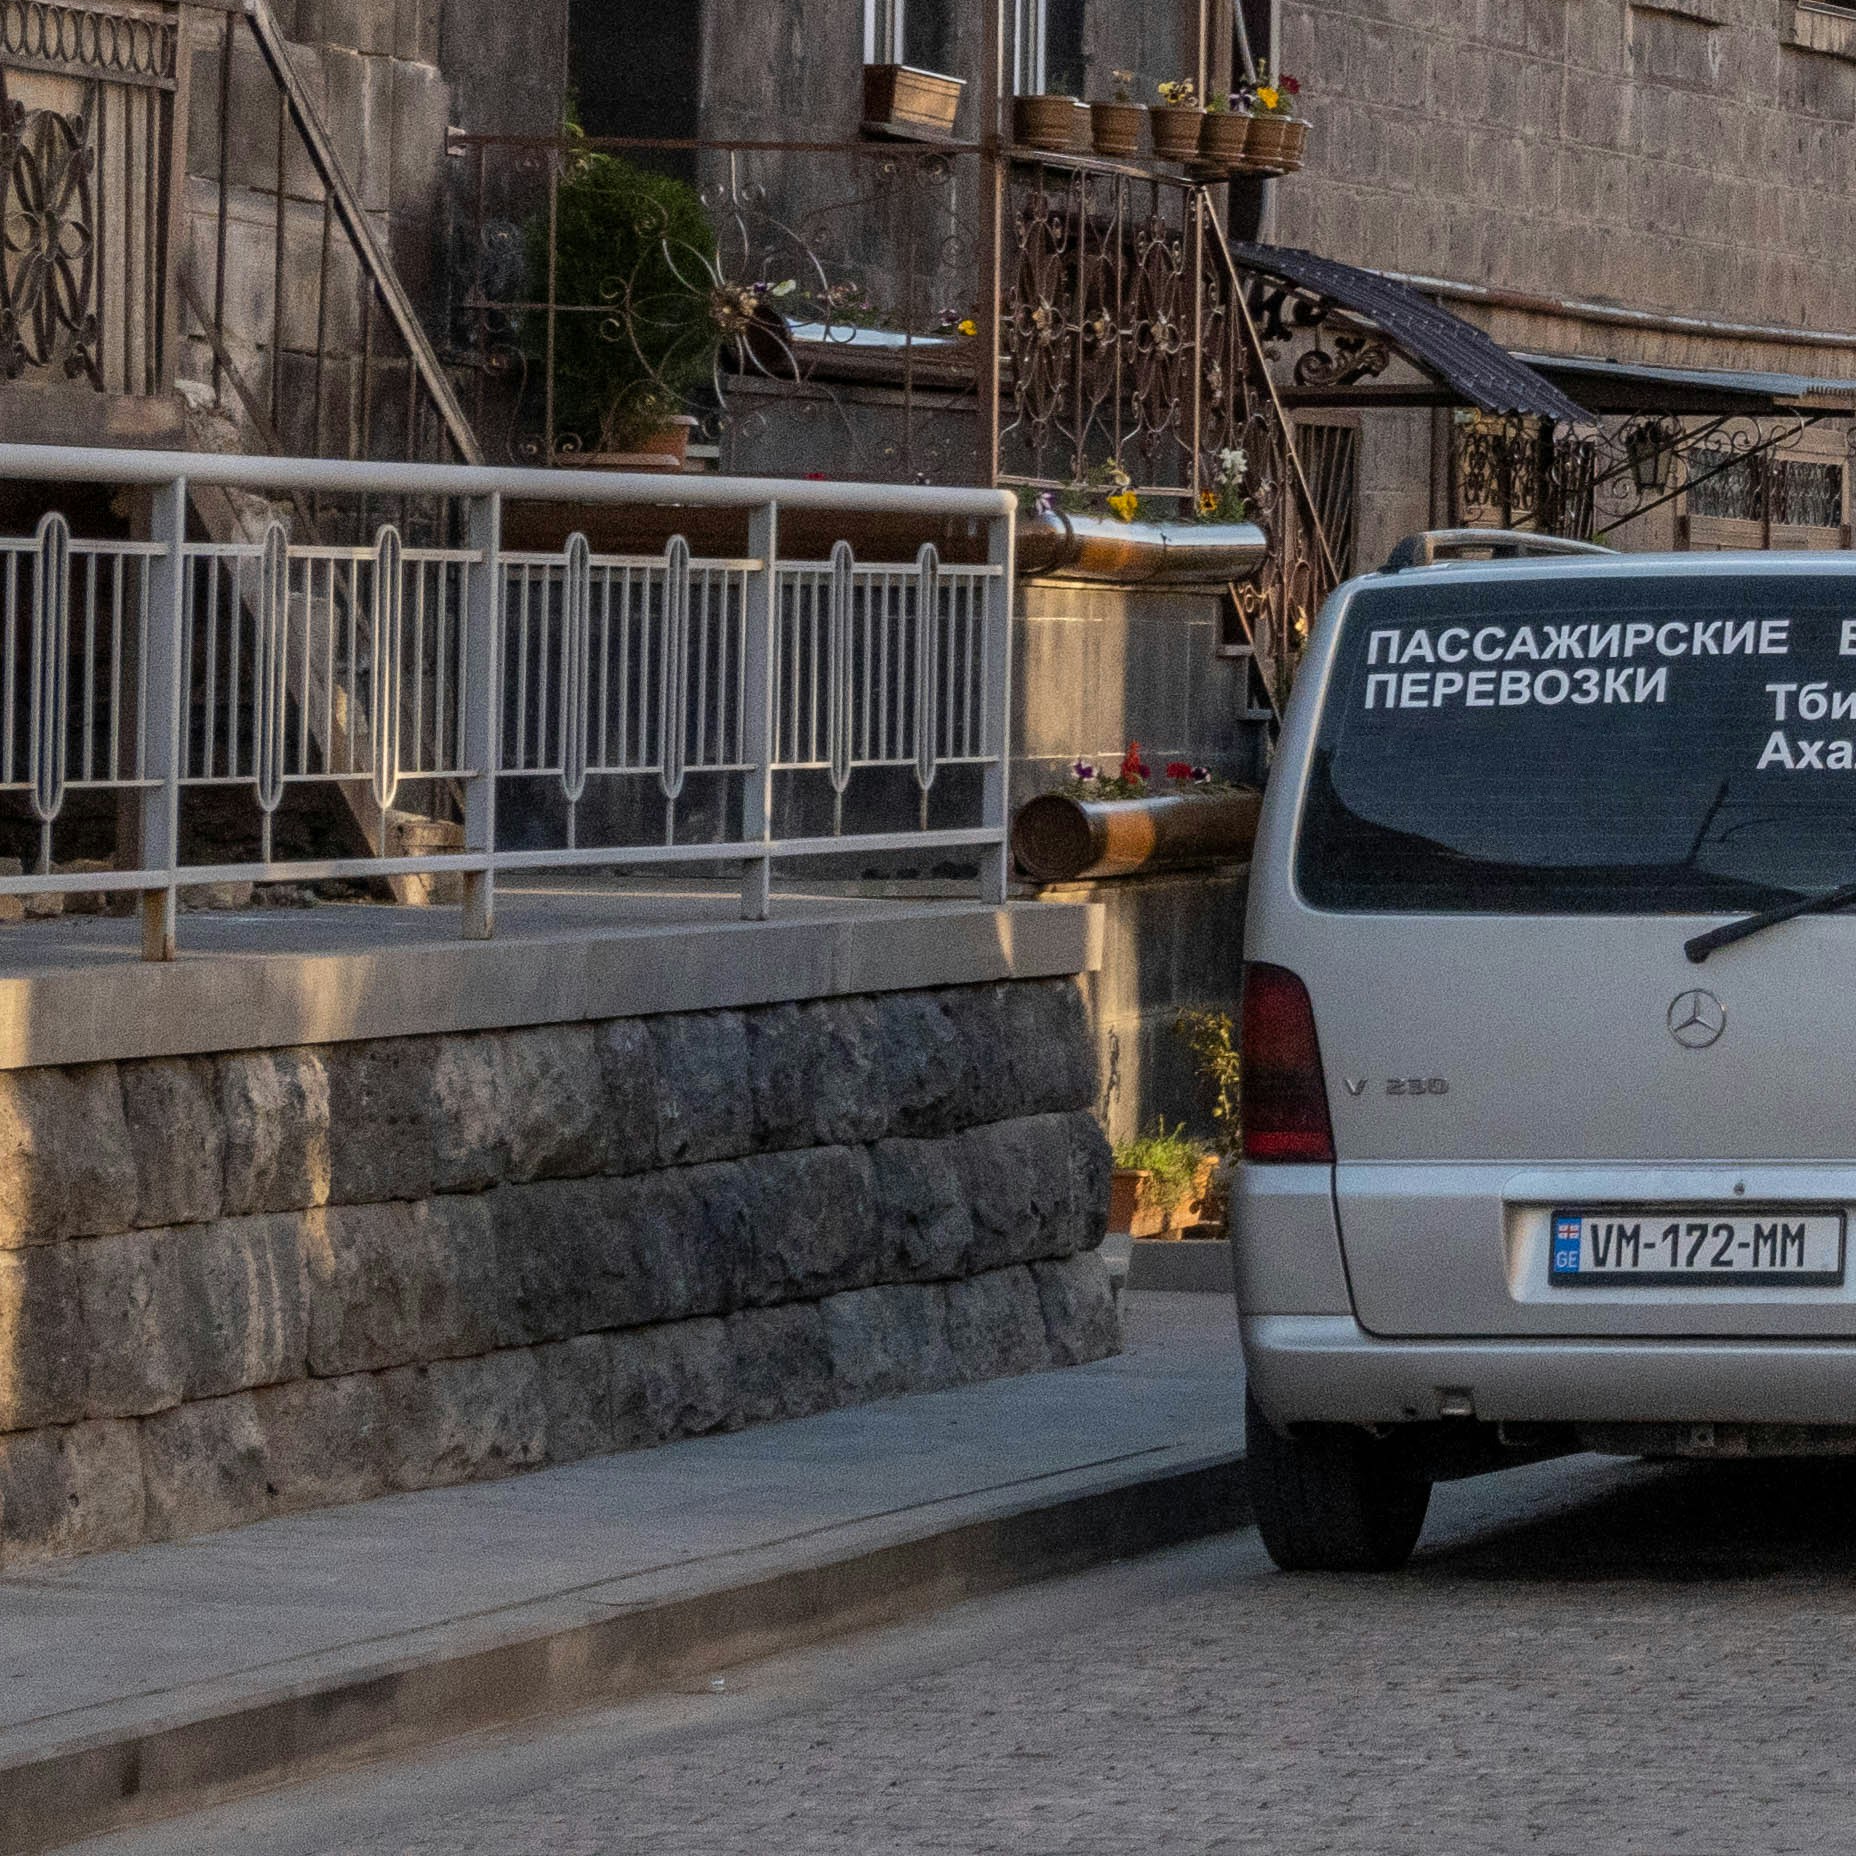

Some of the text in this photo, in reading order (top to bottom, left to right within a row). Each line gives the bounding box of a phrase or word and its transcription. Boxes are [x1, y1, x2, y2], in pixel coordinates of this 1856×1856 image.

[1366, 620, 1790, 665] ПАССАЖИРСКИЕ
[1364, 666, 1668, 709] ПЕРЕВОЗКИ
[1344, 1078, 1368, 1096] V
[1556, 1250, 1579, 1268] GE
[1590, 1223, 1806, 1268] VM-172-MM
